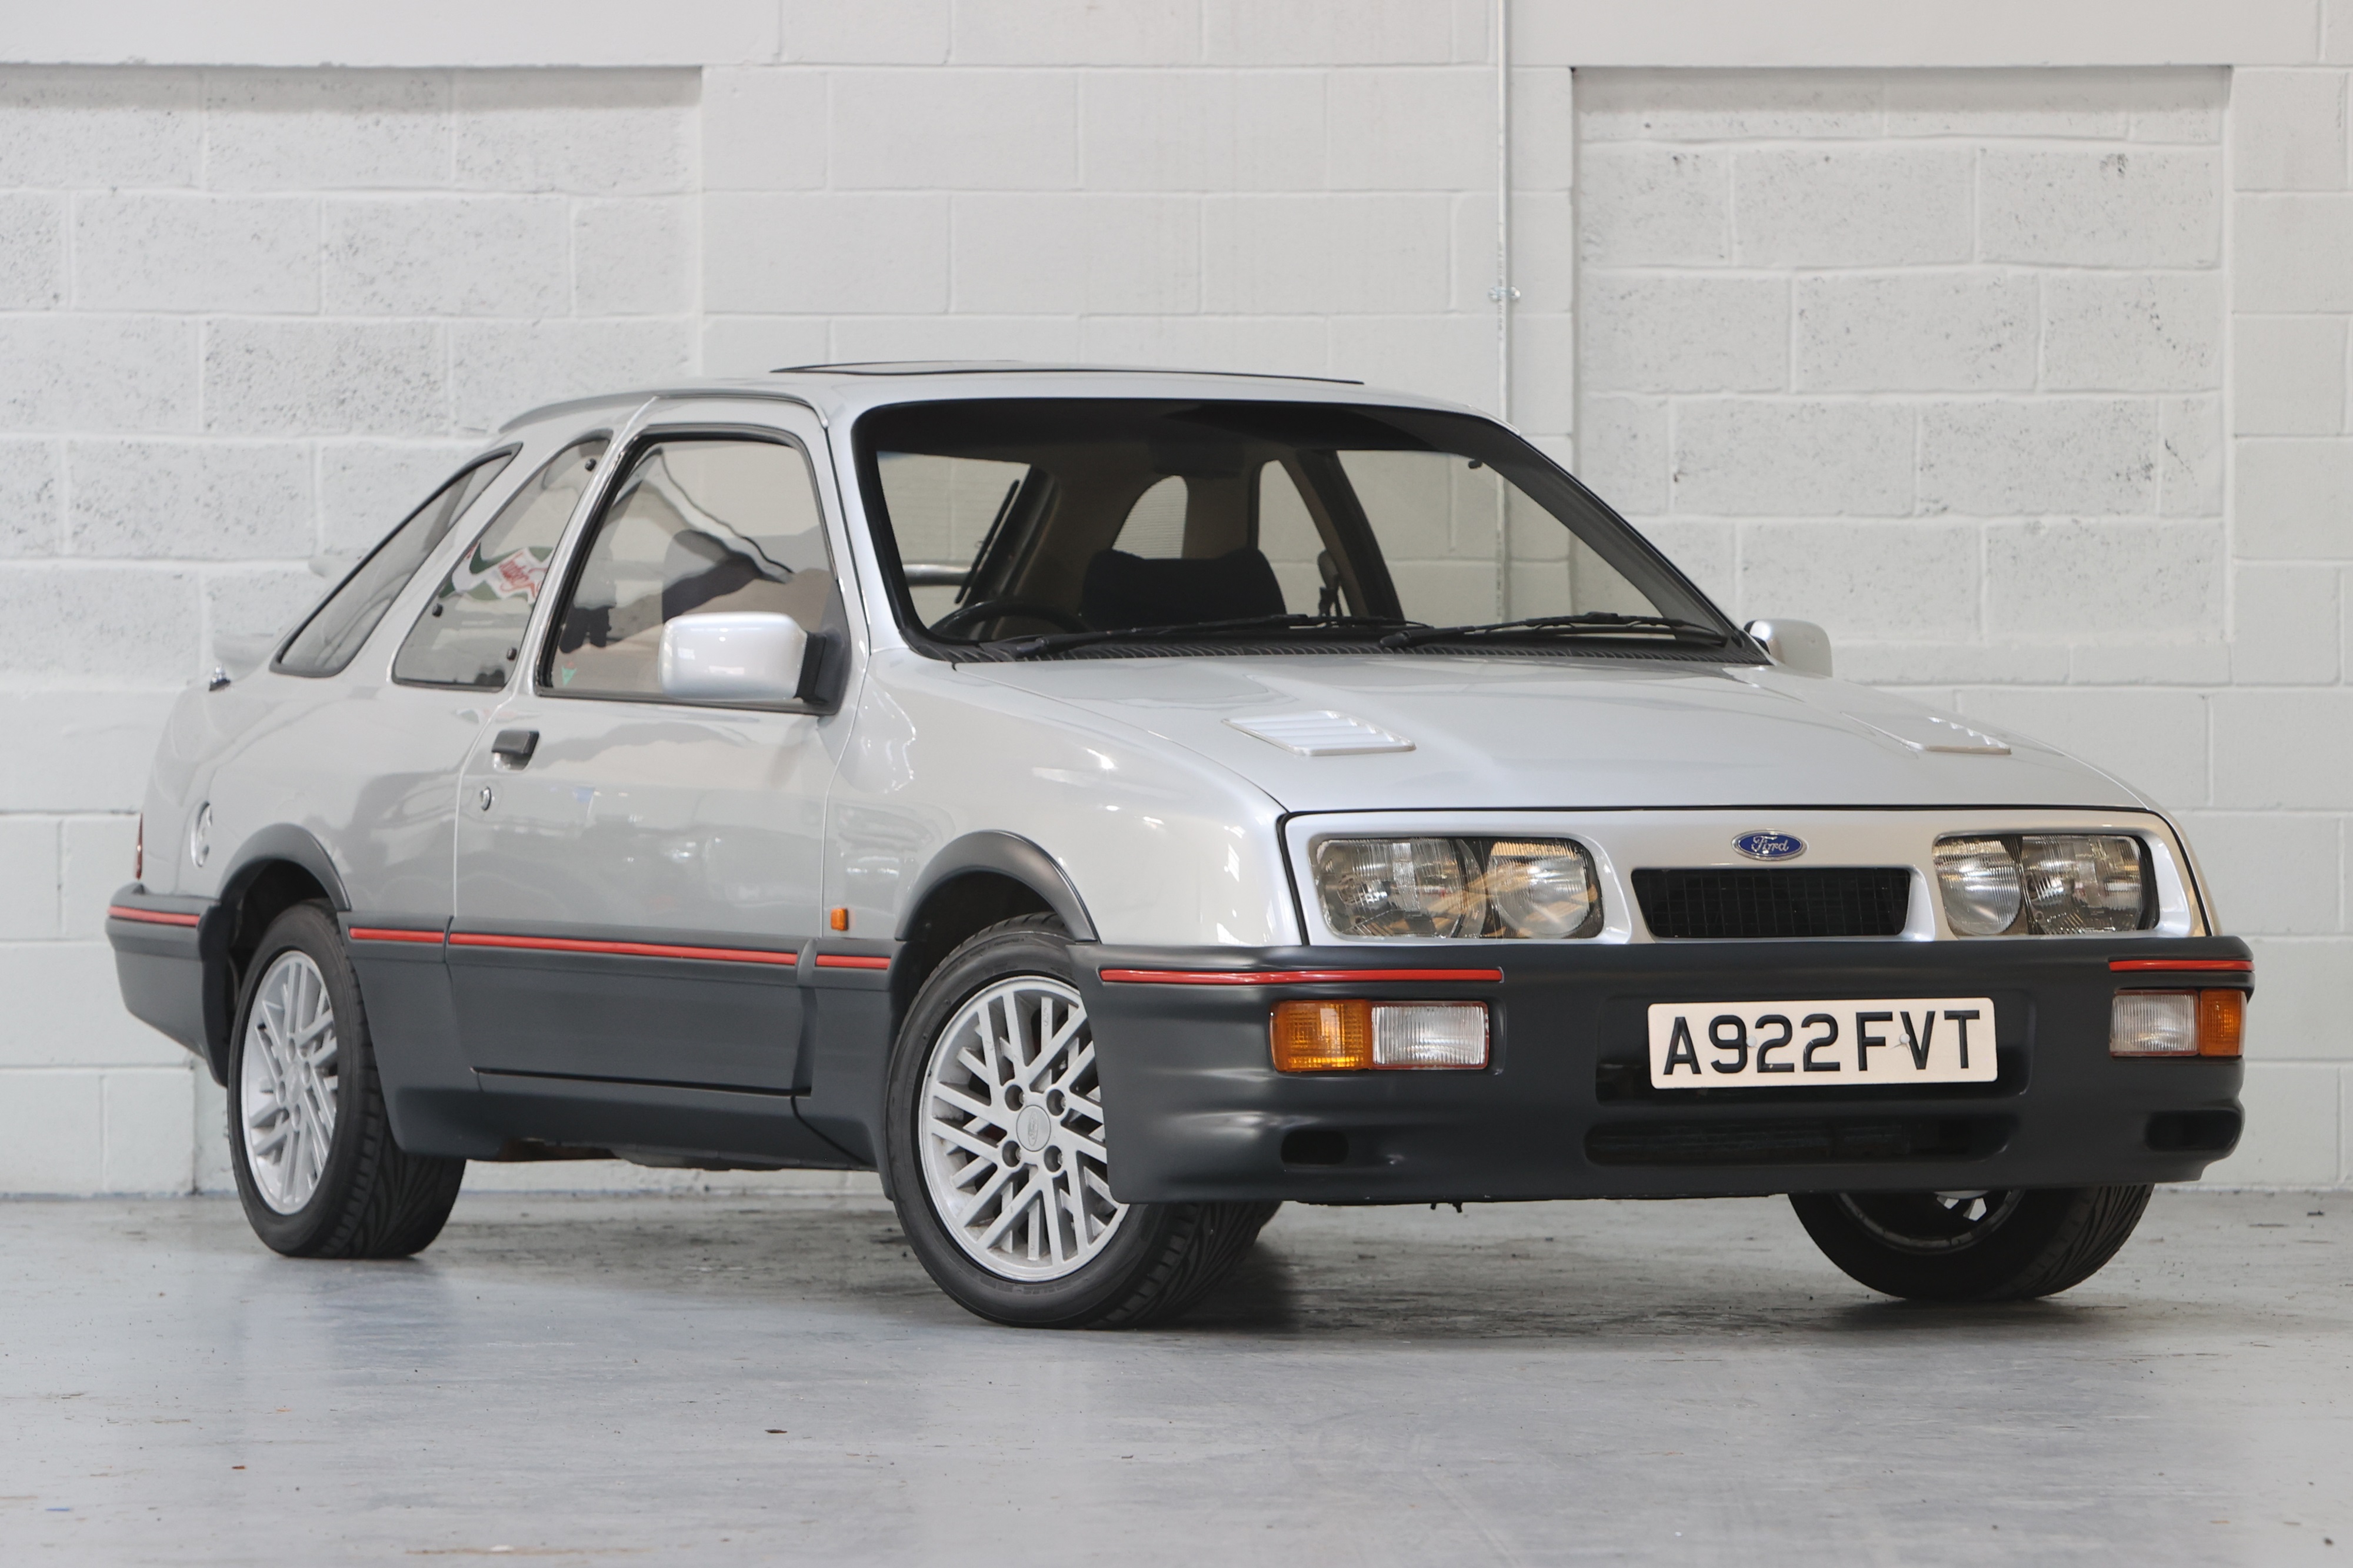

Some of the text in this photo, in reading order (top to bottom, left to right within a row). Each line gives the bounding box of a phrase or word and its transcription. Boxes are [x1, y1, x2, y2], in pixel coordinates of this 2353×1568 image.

[1751, 835, 1789, 852] Ford
[1664, 1010, 1980, 1075] A922 FVT
